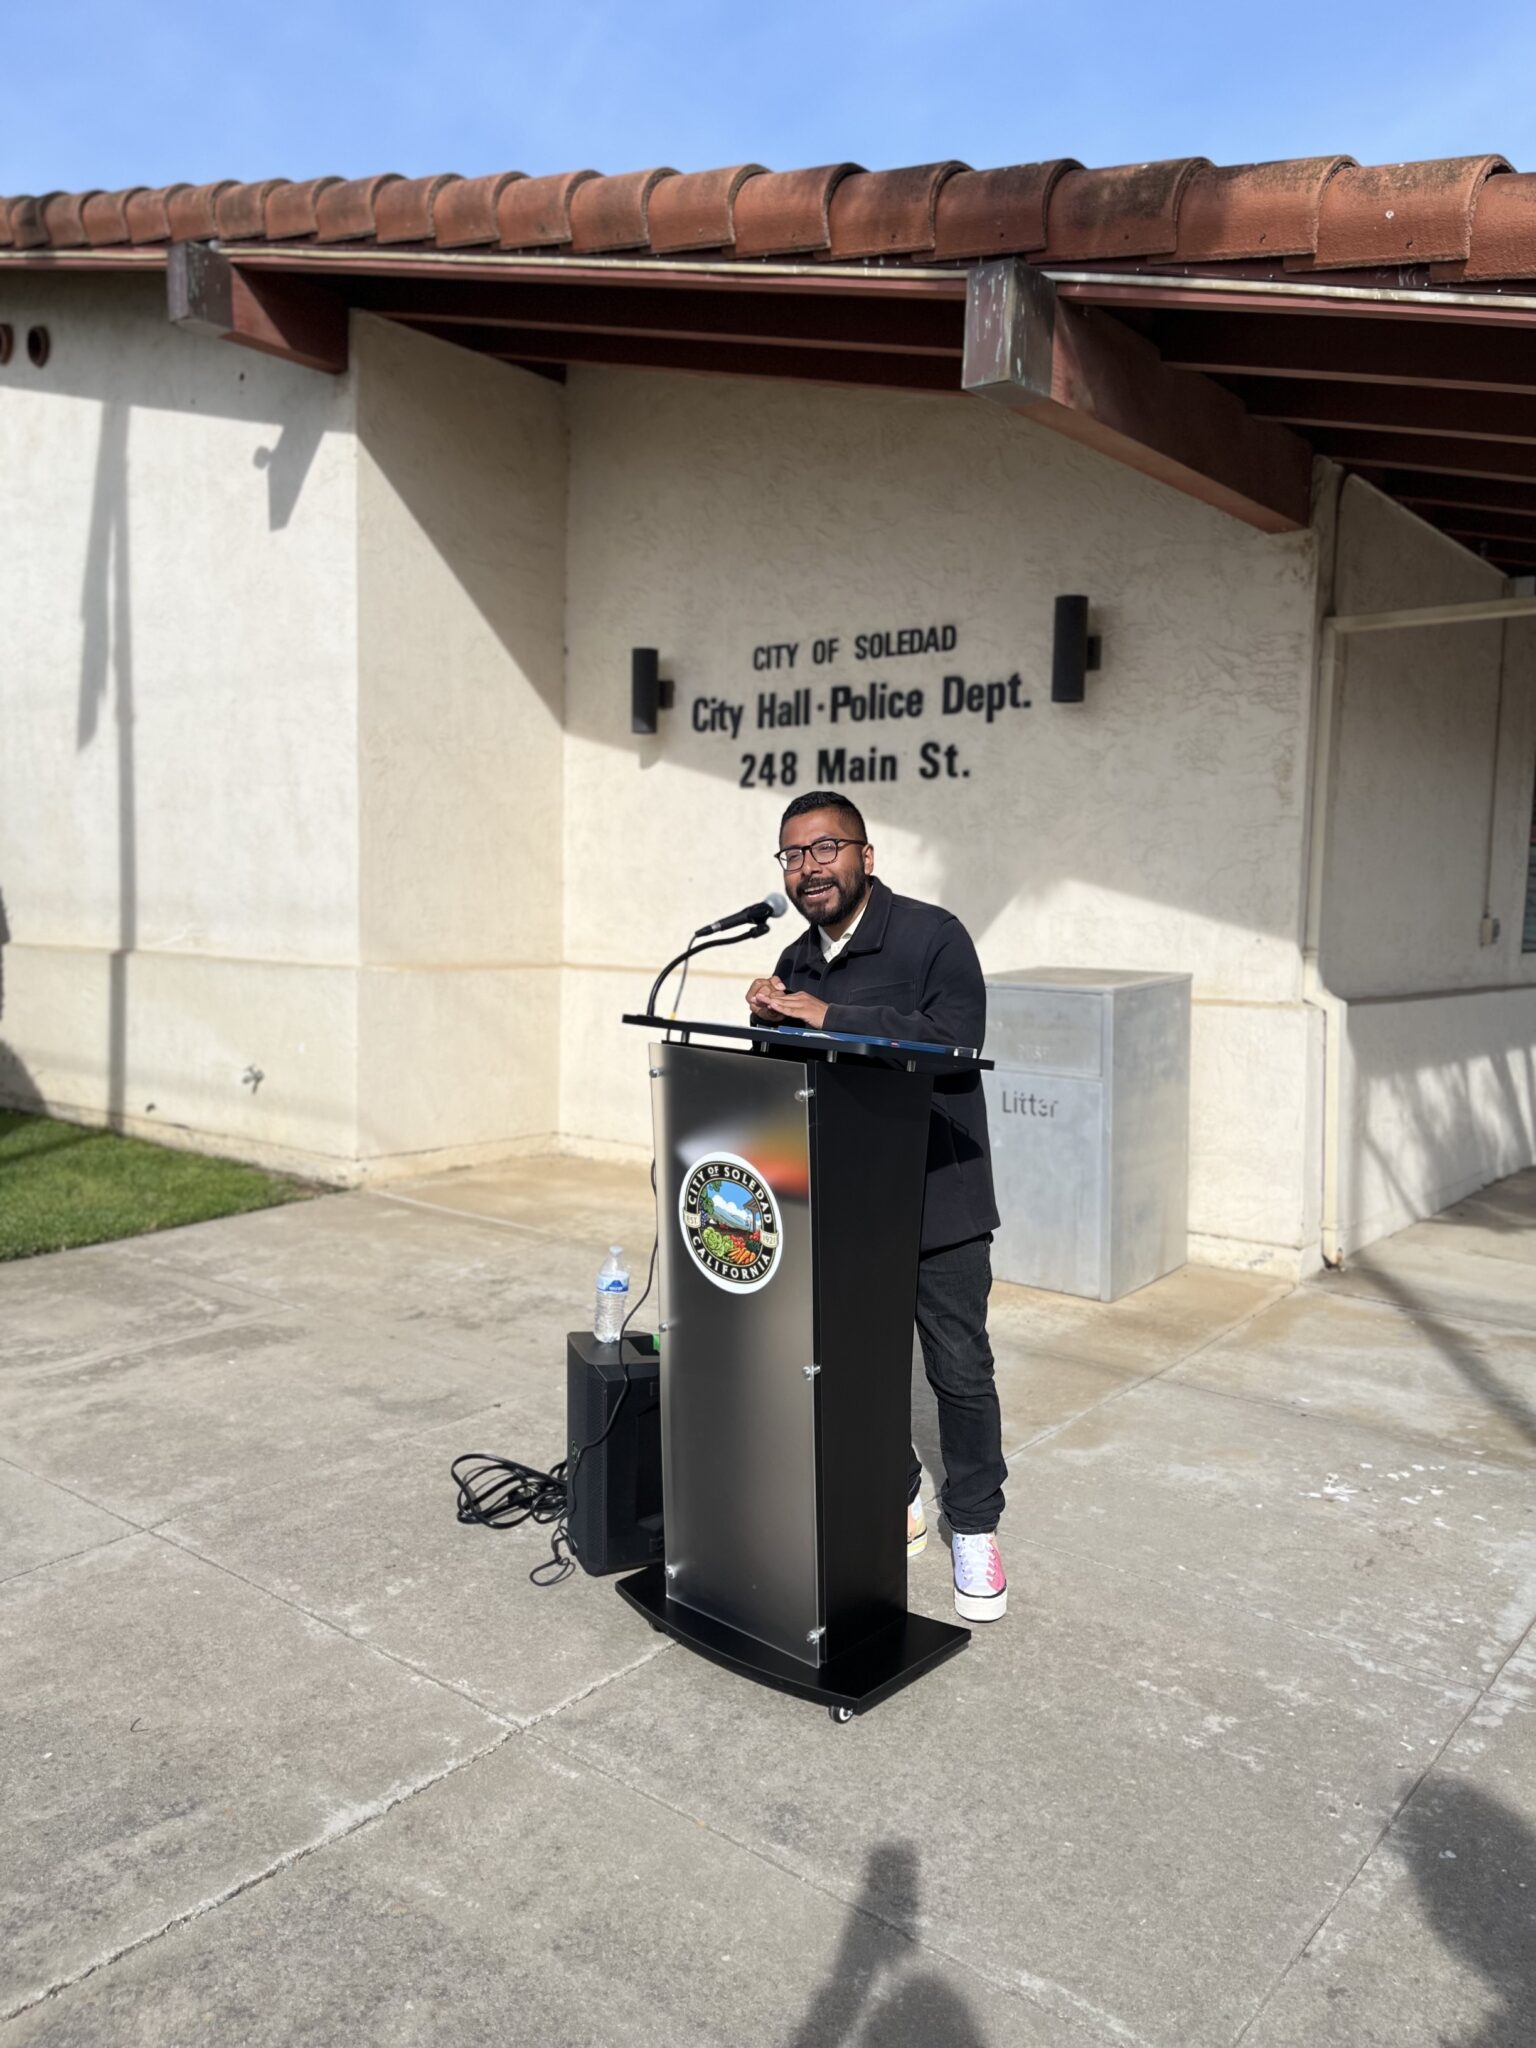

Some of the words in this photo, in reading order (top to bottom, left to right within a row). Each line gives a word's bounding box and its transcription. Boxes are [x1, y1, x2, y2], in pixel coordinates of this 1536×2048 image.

[753, 643, 798, 671] CITY
[812, 638, 839, 665] OF
[854, 624, 957, 660] SOLEDAD
[692, 697, 744, 739] City
[942, 672, 1032, 723] Dept.
[739, 751, 798, 788] 248
[816, 747, 898, 785] Main
[919, 741, 970, 780] St.
[688, 1172, 706, 1205] CITY
[707, 1165, 719, 1177] OF
[724, 1166, 773, 1224] SOLEDAD
[692, 1235, 771, 1280] CALIFORNIA
